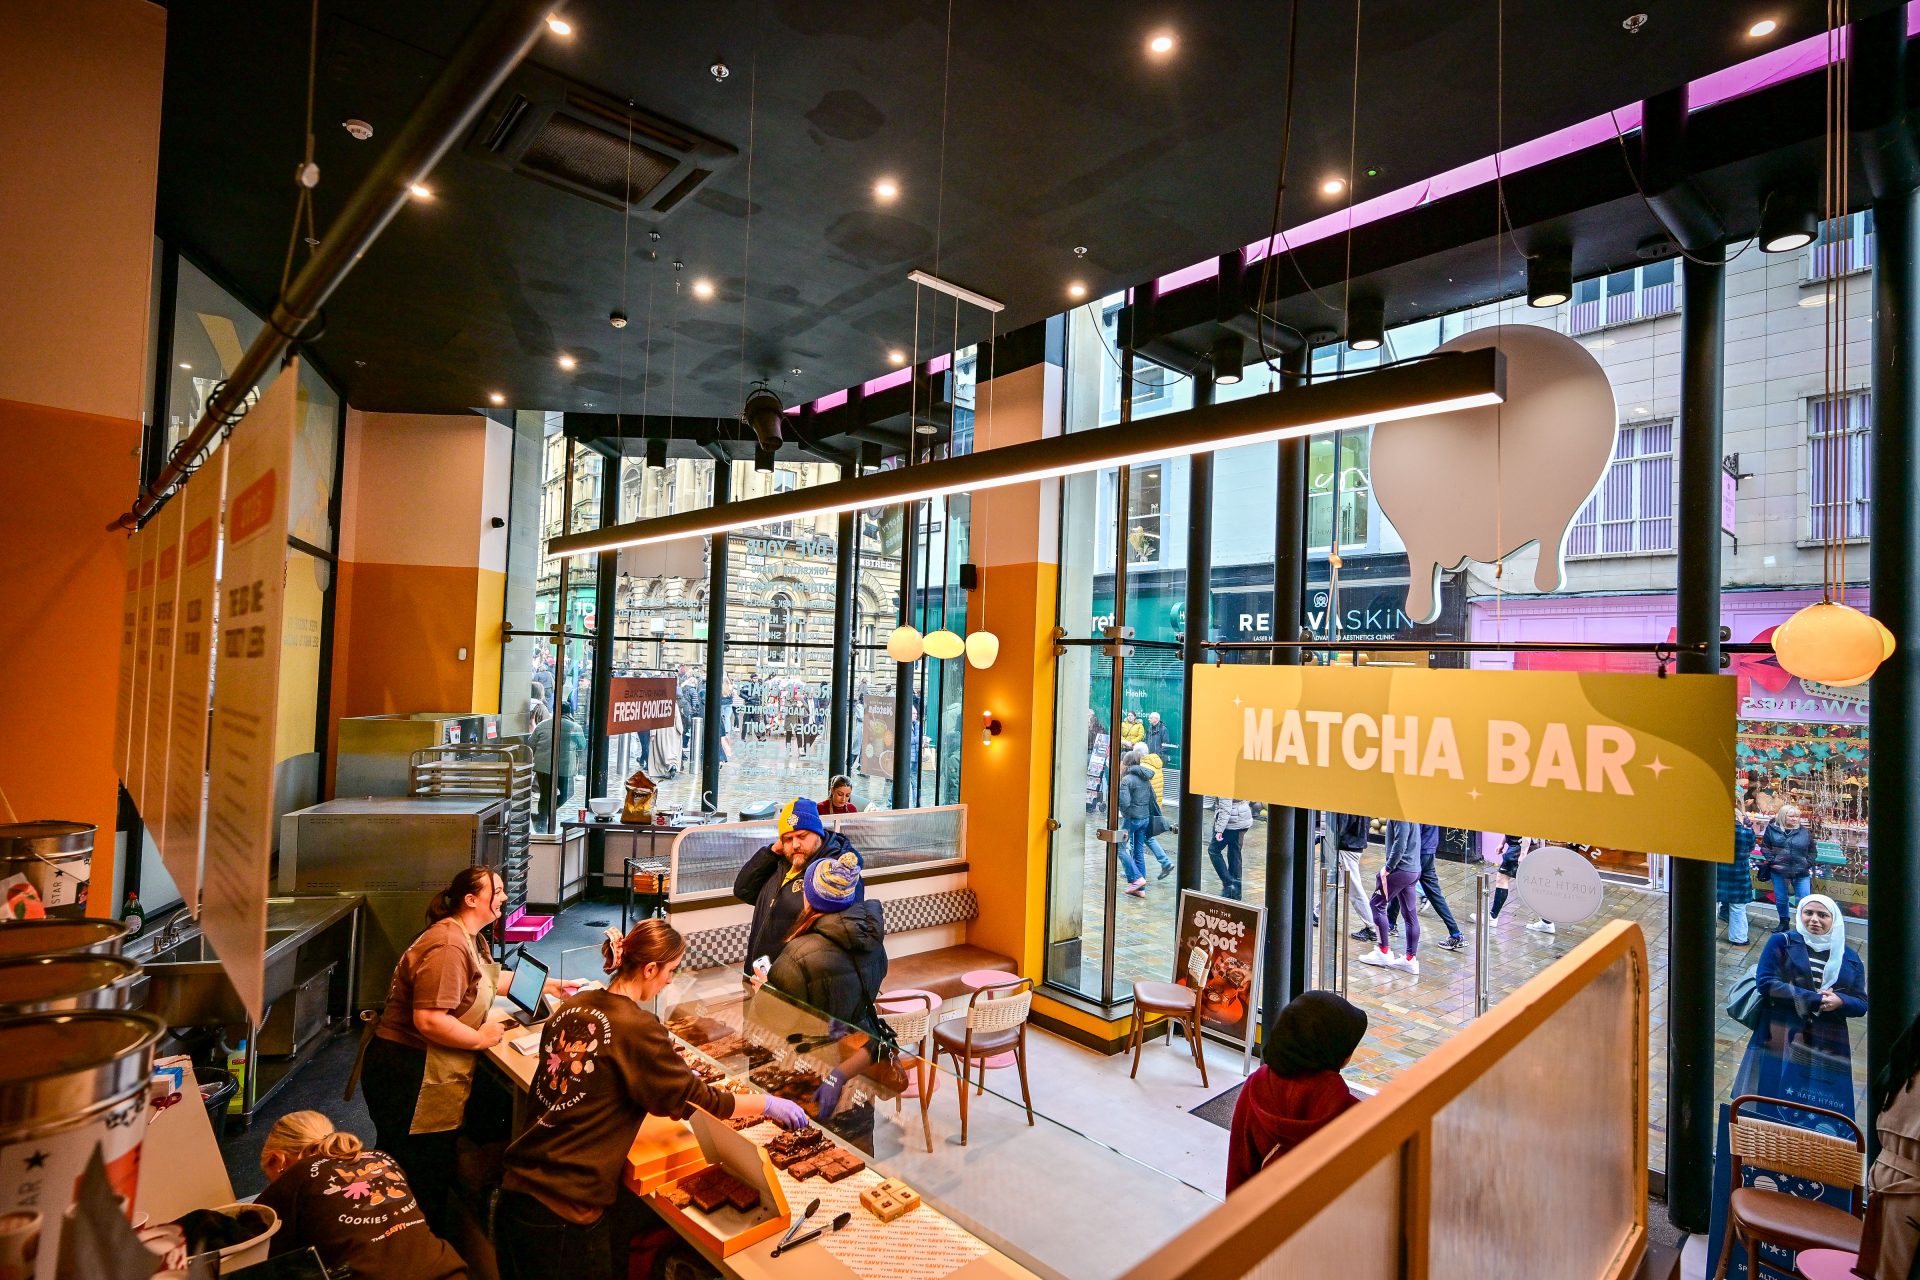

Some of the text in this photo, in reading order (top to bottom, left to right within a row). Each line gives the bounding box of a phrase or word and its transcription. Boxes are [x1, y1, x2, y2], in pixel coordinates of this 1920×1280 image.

[624, 689, 651, 699] BAKING
[1125, 689, 1148, 698] Health
[613, 699, 673, 723] FRESH COOKIES
[1243, 707, 1635, 796] MATCHA BAR
[52, 881, 63, 905] STAR
[1811, 884, 1867, 899] MAGICAL
[1194, 910, 1246, 938] Sweet
[1199, 928, 1238, 953] Spot
[551, 1007, 582, 1028] COFFEE
[590, 1008, 612, 1045] BROWNIES
[550, 1092, 587, 1111] MATCHA
[338, 1214, 389, 1225] COOKIES
[371, 1234, 385, 1242] THE
[384, 1222, 406, 1237] SAVVY
[1761, 1241, 1768, 1250] N
